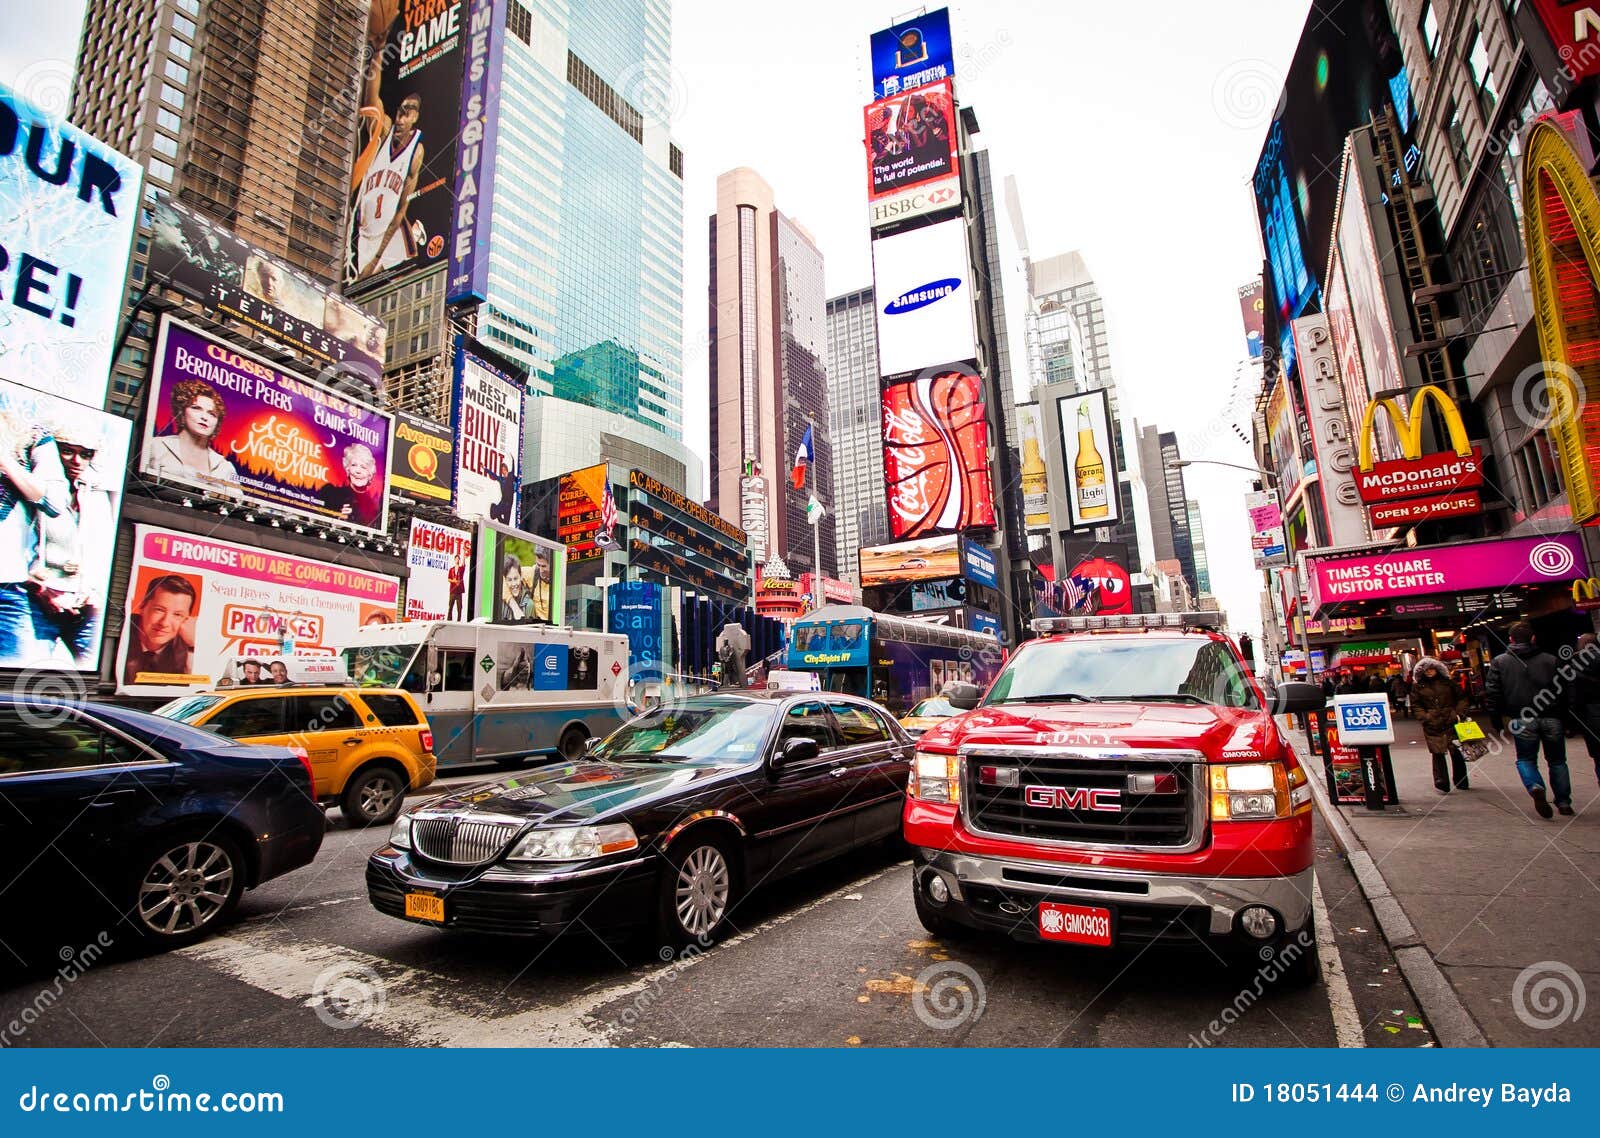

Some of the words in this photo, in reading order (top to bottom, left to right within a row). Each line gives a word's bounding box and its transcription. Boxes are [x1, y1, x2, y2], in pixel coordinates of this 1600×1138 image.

[405, 0, 459, 32] YORK
[400, 2, 461, 63] GAME
[456, 94, 484, 258] SQUARE
[873, 165, 890, 175] The
[891, 156, 914, 170] world
[874, 177, 882, 185] is
[883, 171, 896, 182] full
[897, 169, 906, 177] of
[907, 158, 946, 177] potential.
[375, 194, 384, 218] 1
[874, 194, 925, 220] HSBC
[0, 245, 83, 328] E!
[893, 285, 953, 308] SAMSUNG
[218, 288, 347, 361] TEMPEST
[175, 347, 253, 399] BERNADETTE
[255, 379, 293, 412] PETERS
[207, 343, 276, 382] CLOSES
[277, 379, 347, 418] JANUARY
[479, 380, 508, 405] BEST
[465, 386, 518, 425] MUSICAL
[1307, 327, 1358, 505] PALACE
[314, 404, 347, 436] ELAINE
[348, 418, 380, 448] STRITCH
[396, 422, 452, 454] Avenue
[464, 403, 501, 448] BILLY
[408, 443, 438, 481] Q
[462, 437, 505, 481] ELLIOT
[1363, 462, 1476, 488] McDonald's
[1381, 477, 1458, 495] Restaurant
[645, 477, 662, 494] APP
[662, 486, 687, 510] STORE
[687, 500, 708, 521] OPENS
[709, 513, 721, 529] FOR
[720, 519, 748, 546] BUSINESS
[1375, 508, 1410, 519] OPEN
[1413, 505, 1429, 515] 24
[1432, 499, 1476, 512] HOURS
[412, 527, 472, 558] HEIGHTS
[171, 541, 238, 567] PROMISE
[240, 553, 266, 572] YOU
[268, 561, 293, 578] ARE
[295, 565, 331, 583] GOING
[332, 571, 346, 585] TO
[348, 573, 373, 592] LOVE
[427, 559, 449, 571] MUSICAL
[1326, 565, 1370, 581] TIMES
[1374, 559, 1433, 577] SQUARE
[210, 580, 237, 598] Sean
[240, 586, 271, 600] Hayes
[1328, 578, 1384, 595] VISITOR
[1388, 572, 1445, 588] CENTER
[804, 654, 840, 665] CitySights
[1345, 715, 1382, 726] TODAY
[1356, 707, 1380, 717] USA
[1036, 732, 1120, 745] F.D.N.Y.
[1024, 784, 1122, 812] GMC
